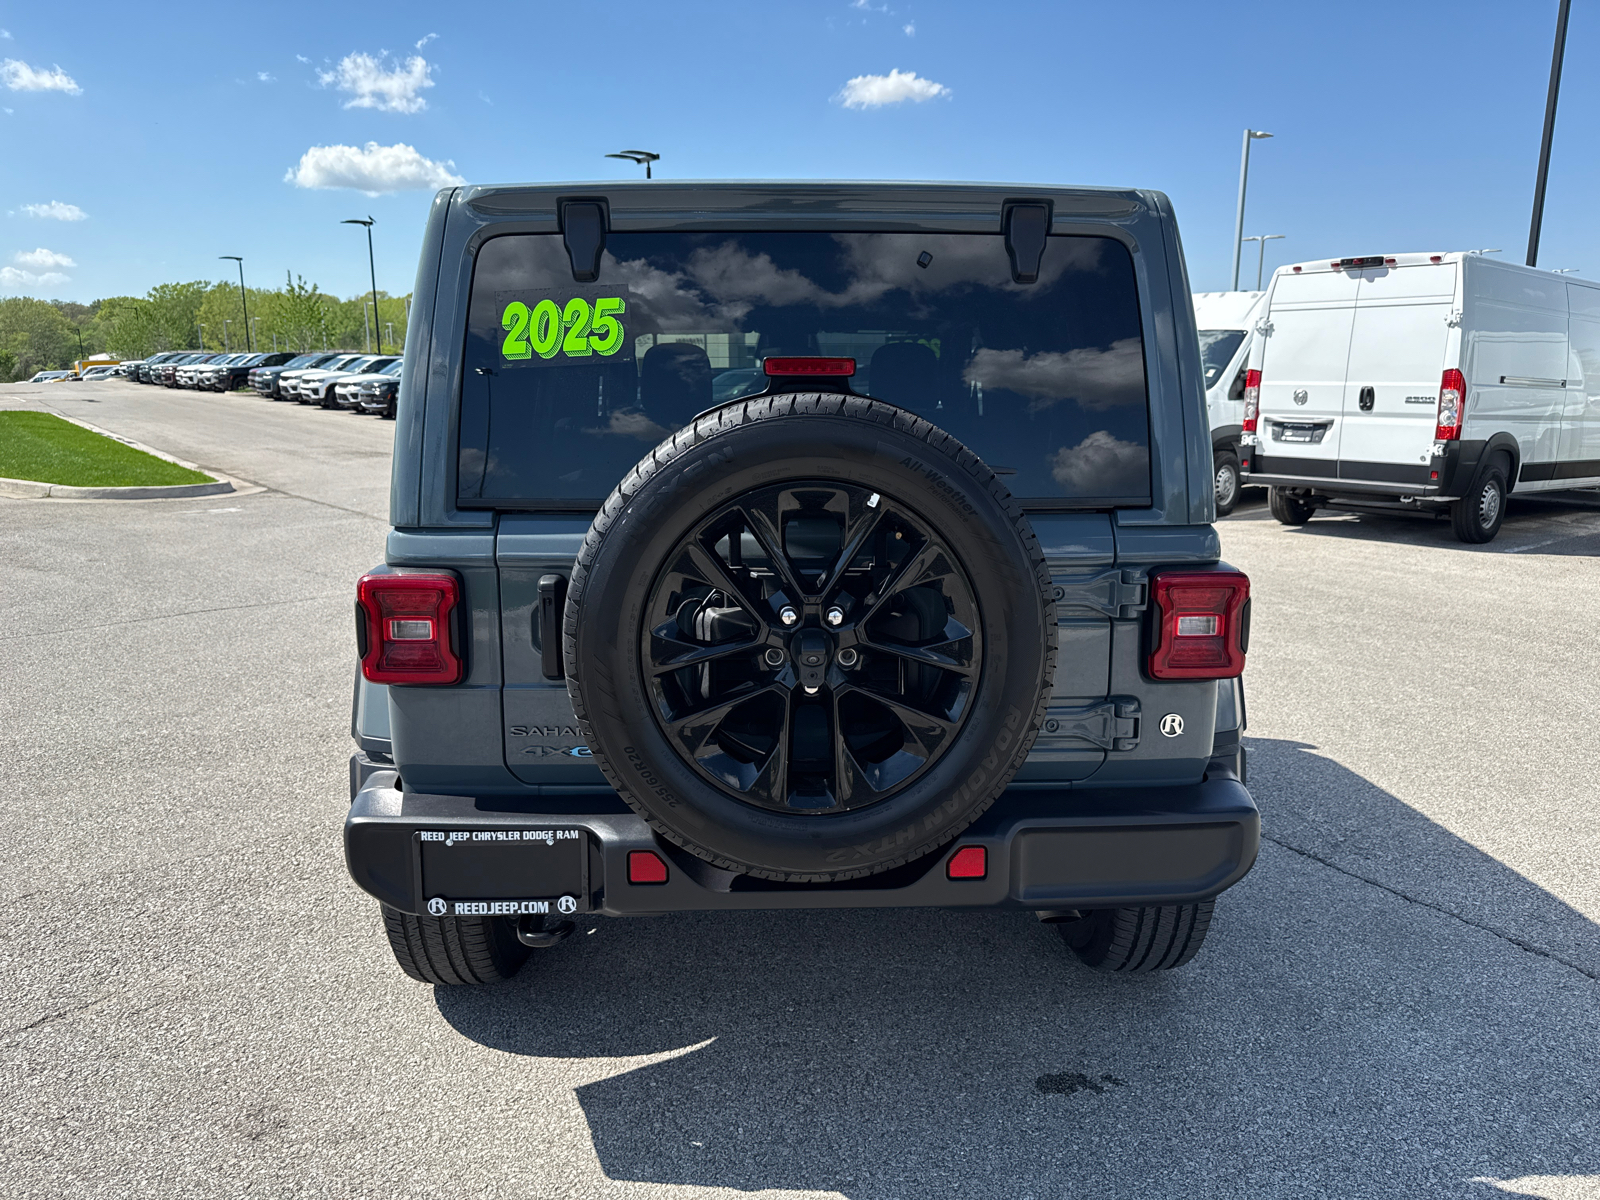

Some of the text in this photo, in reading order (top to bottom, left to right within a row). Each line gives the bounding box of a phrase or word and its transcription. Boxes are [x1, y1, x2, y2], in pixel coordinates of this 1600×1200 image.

[502, 298, 625, 360] 2025
[899, 456, 979, 517] All-Weather
[927, 485, 970, 523] Performance
[624, 745, 680, 809] 255/60R20
[923, 704, 1022, 829] ROADIAN
[421, 830, 579, 841] REED JEEP CHRYSLER DODGE RAM
[455, 902, 549, 914] REEDJEEP.COM
